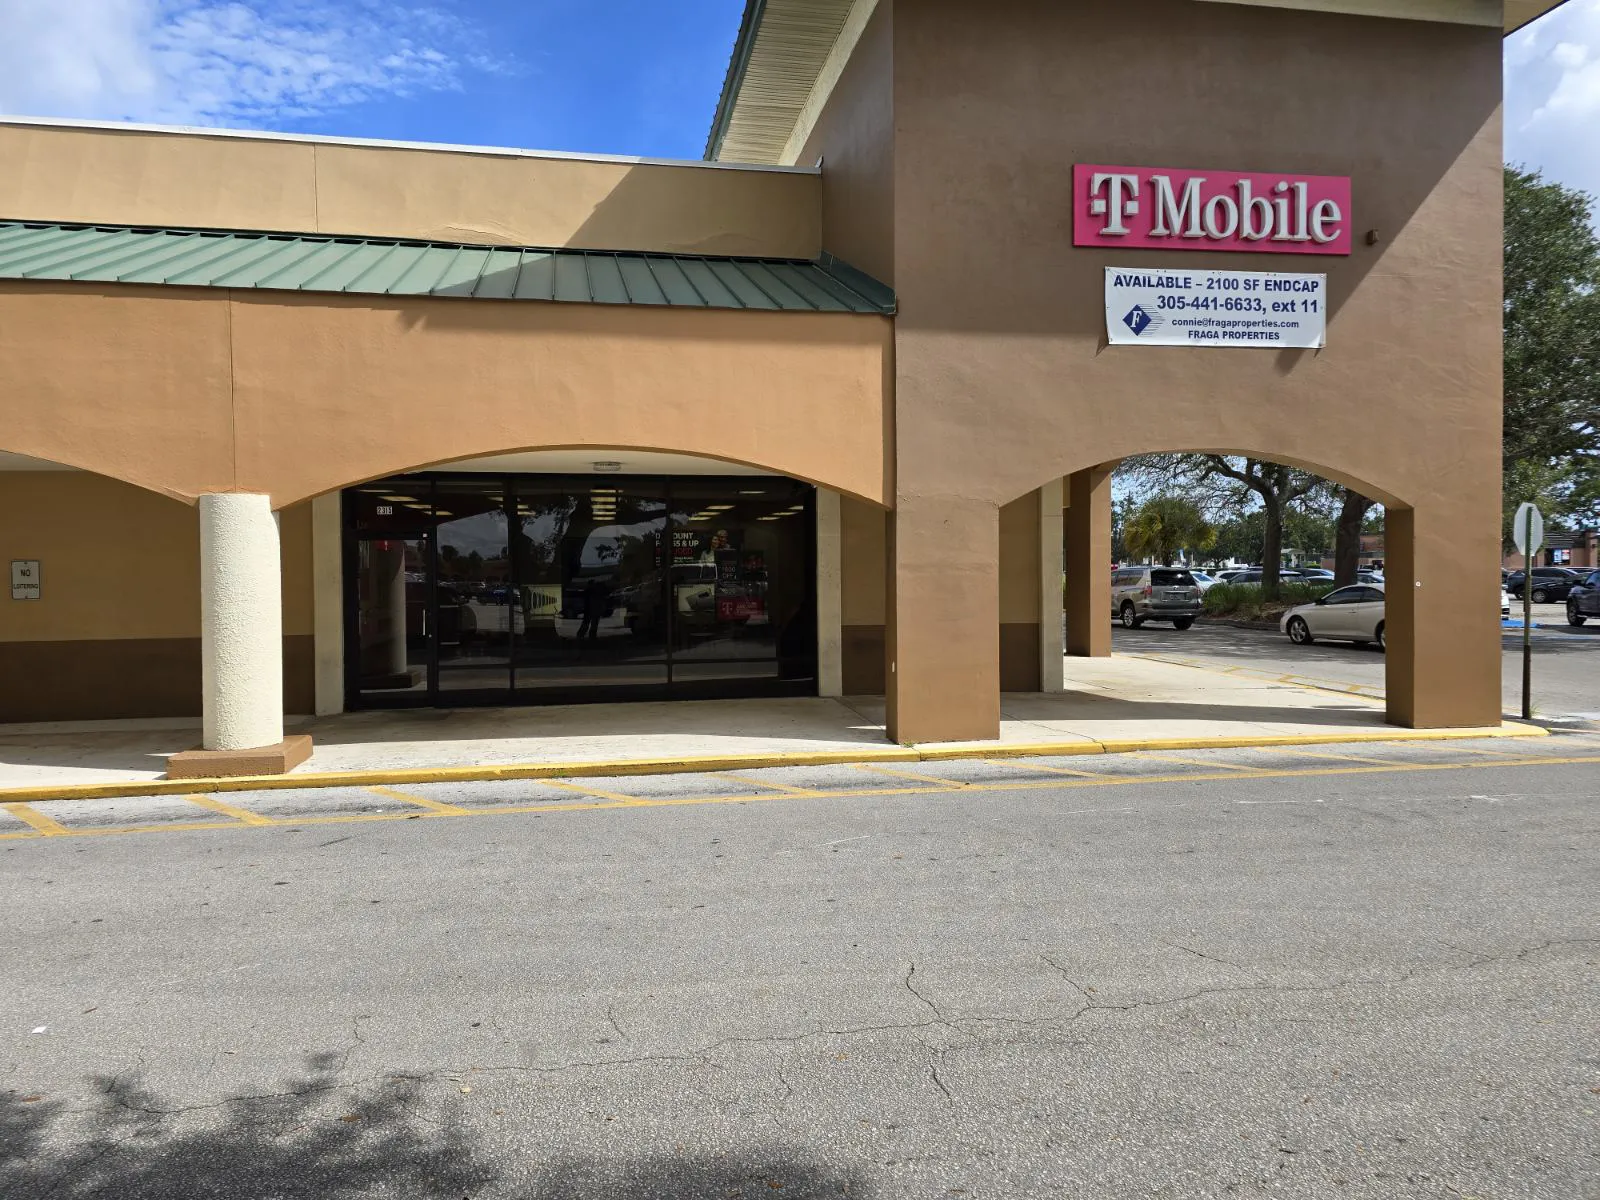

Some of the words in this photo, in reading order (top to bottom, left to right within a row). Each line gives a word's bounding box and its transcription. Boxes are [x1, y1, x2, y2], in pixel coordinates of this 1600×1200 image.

[1113, 274, 1193, 290] AVAILABLE
[1206, 278, 1240, 291] 2100
[1242, 279, 1261, 292] SF
[1264, 279, 1320, 293] ENDCAP
[1156, 295, 1268, 315] 305-441-6633,
[1271, 300, 1297, 314] ext
[1301, 299, 1318, 313] 11
[1171, 317, 1300, 330] connie@fragaproperties.com
[1188, 330, 1220, 340] FRAGA
[1222, 331, 1280, 341] PROPERTIES
[20, 568, 31, 577] NO
